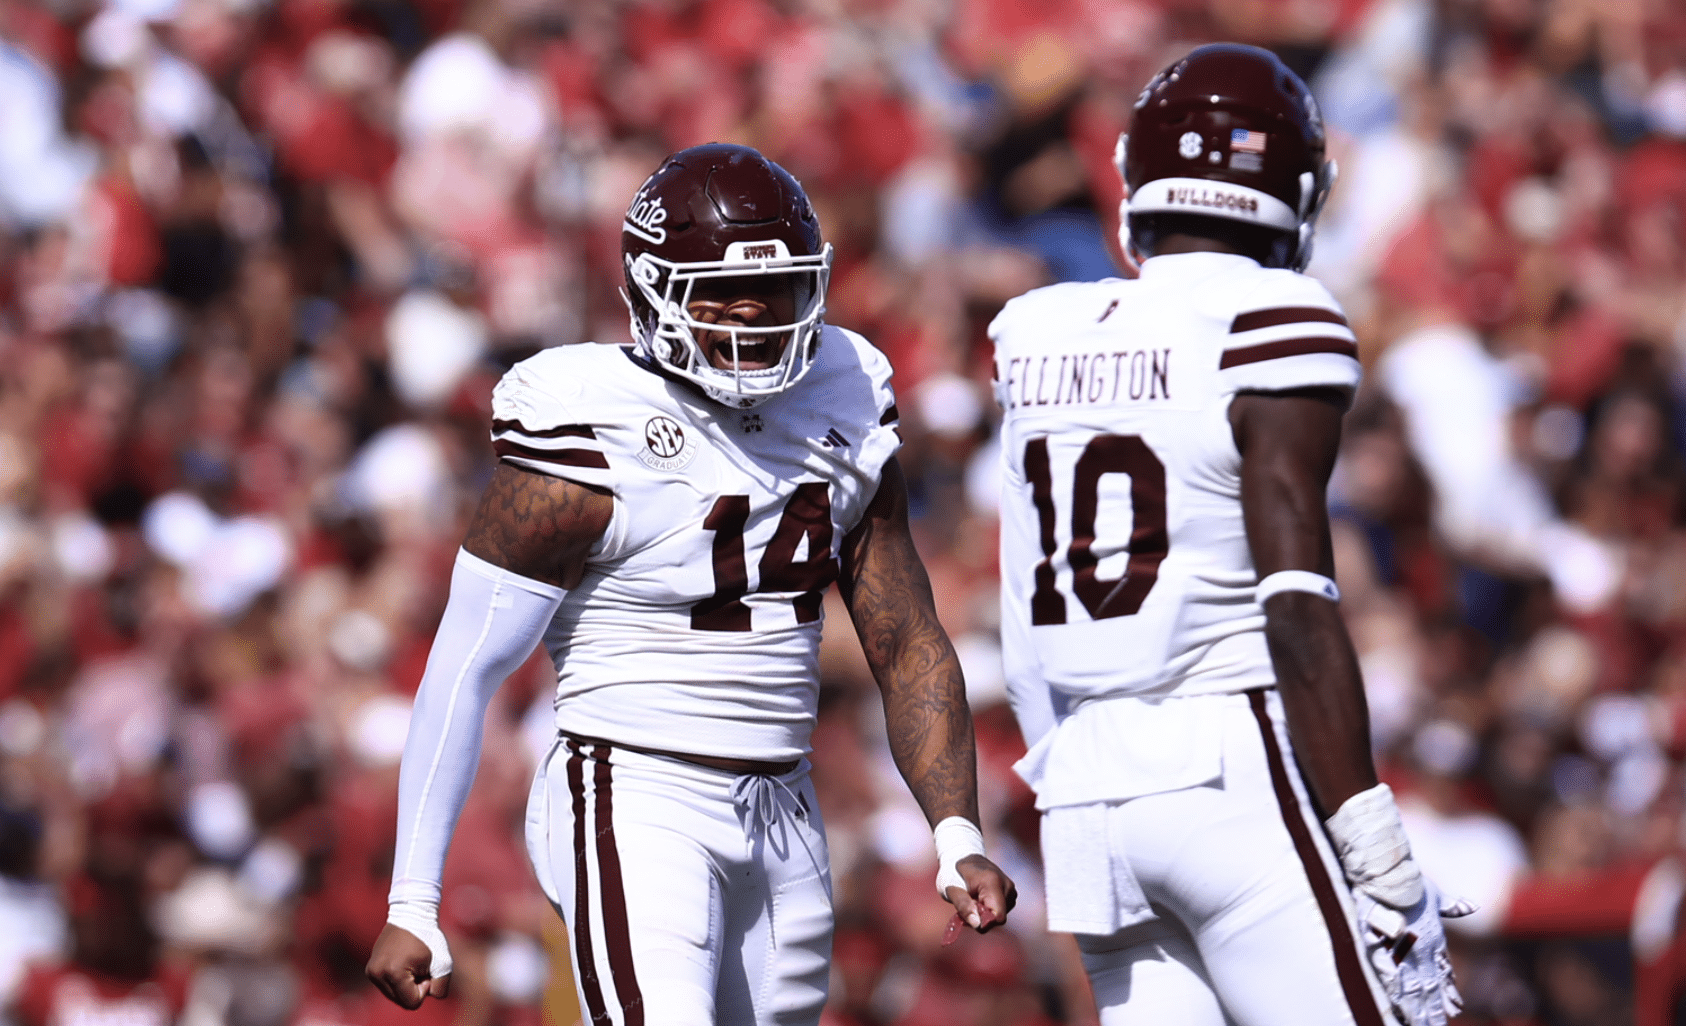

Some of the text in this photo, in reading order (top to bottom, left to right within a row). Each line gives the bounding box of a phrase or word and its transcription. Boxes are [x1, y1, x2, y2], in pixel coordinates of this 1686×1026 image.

[623, 188, 667, 245] tate
[1167, 187, 1258, 212] BULLDOGS
[1008, 349, 1170, 409] ELLINGTON
[645, 416, 685, 458] SEC
[647, 447, 692, 470] GRADUATE
[690, 481, 840, 632] 14
[1023, 432, 1169, 626] 10
